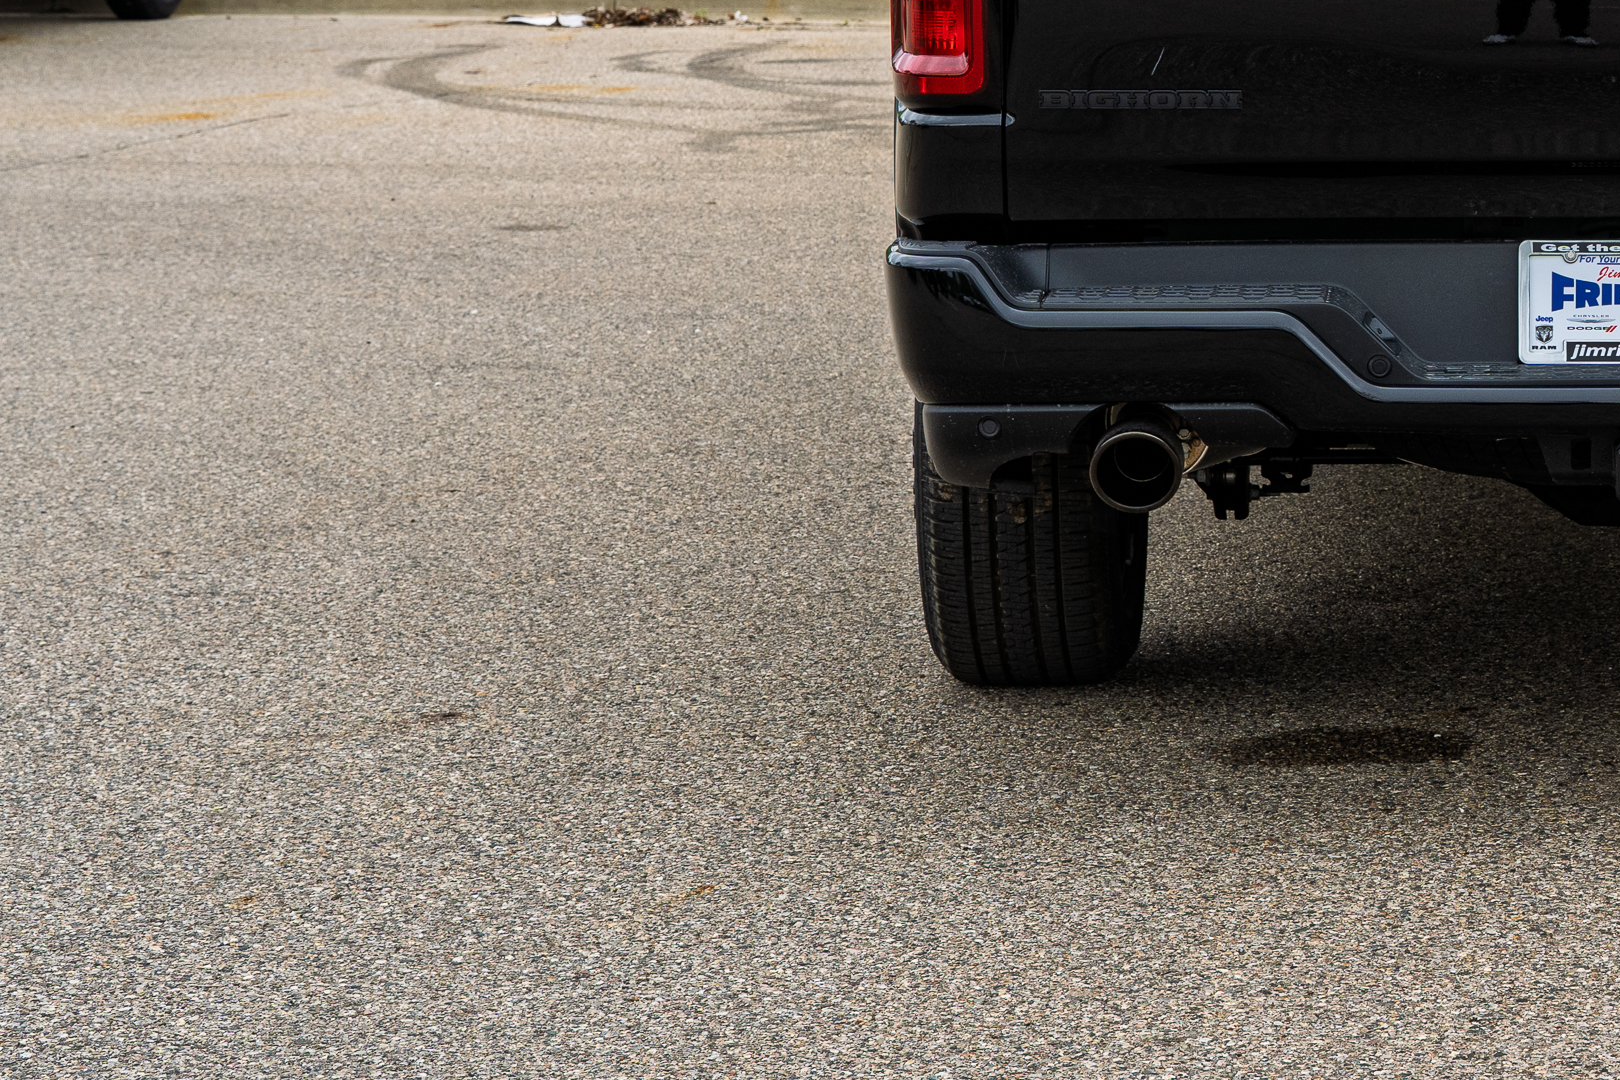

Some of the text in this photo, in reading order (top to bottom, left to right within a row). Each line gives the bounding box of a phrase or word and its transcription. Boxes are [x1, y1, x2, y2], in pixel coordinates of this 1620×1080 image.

[1038, 89, 1243, 110] BIGHORN
[1540, 243, 1580, 252] Get
[1579, 255, 1596, 263] For
[1535, 315, 1554, 323] Jeep
